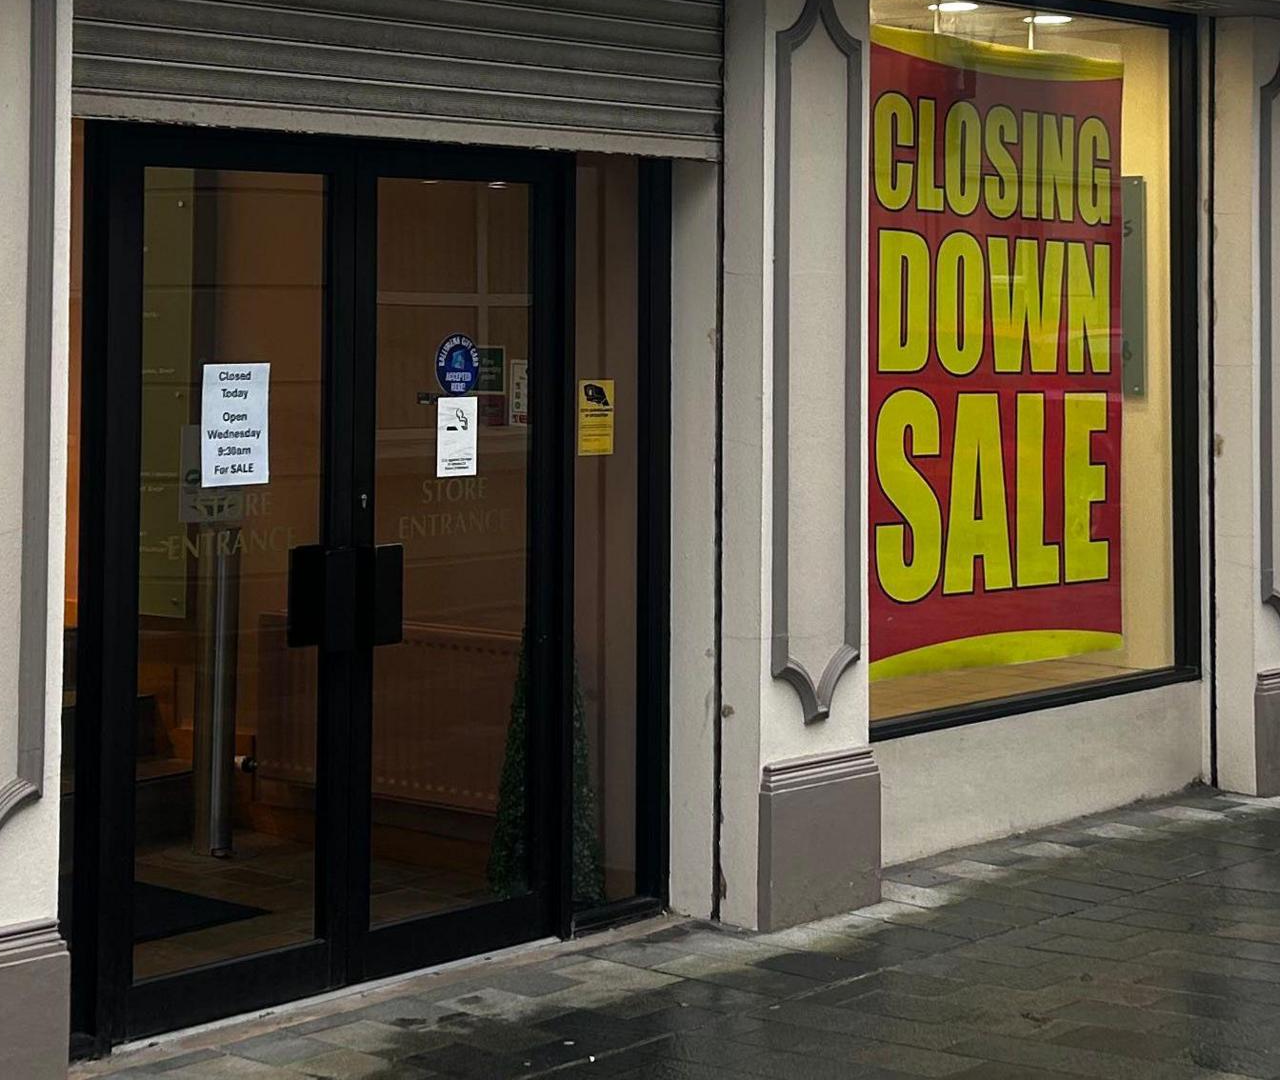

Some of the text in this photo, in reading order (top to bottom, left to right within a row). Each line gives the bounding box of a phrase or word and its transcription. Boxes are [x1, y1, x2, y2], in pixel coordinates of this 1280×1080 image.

[872, 90, 1112, 227] CLOSING
[875, 228, 1112, 377] DOWN
[218, 371, 252, 382] Closed
[221, 388, 249, 400] Today
[222, 411, 248, 423] Open
[207, 428, 262, 440] Wednesday
[214, 462, 255, 475] For SALE
[421, 476, 489, 504] STORE
[874, 387, 1111, 605] SALE
[399, 507, 513, 540] ENTRANCE
